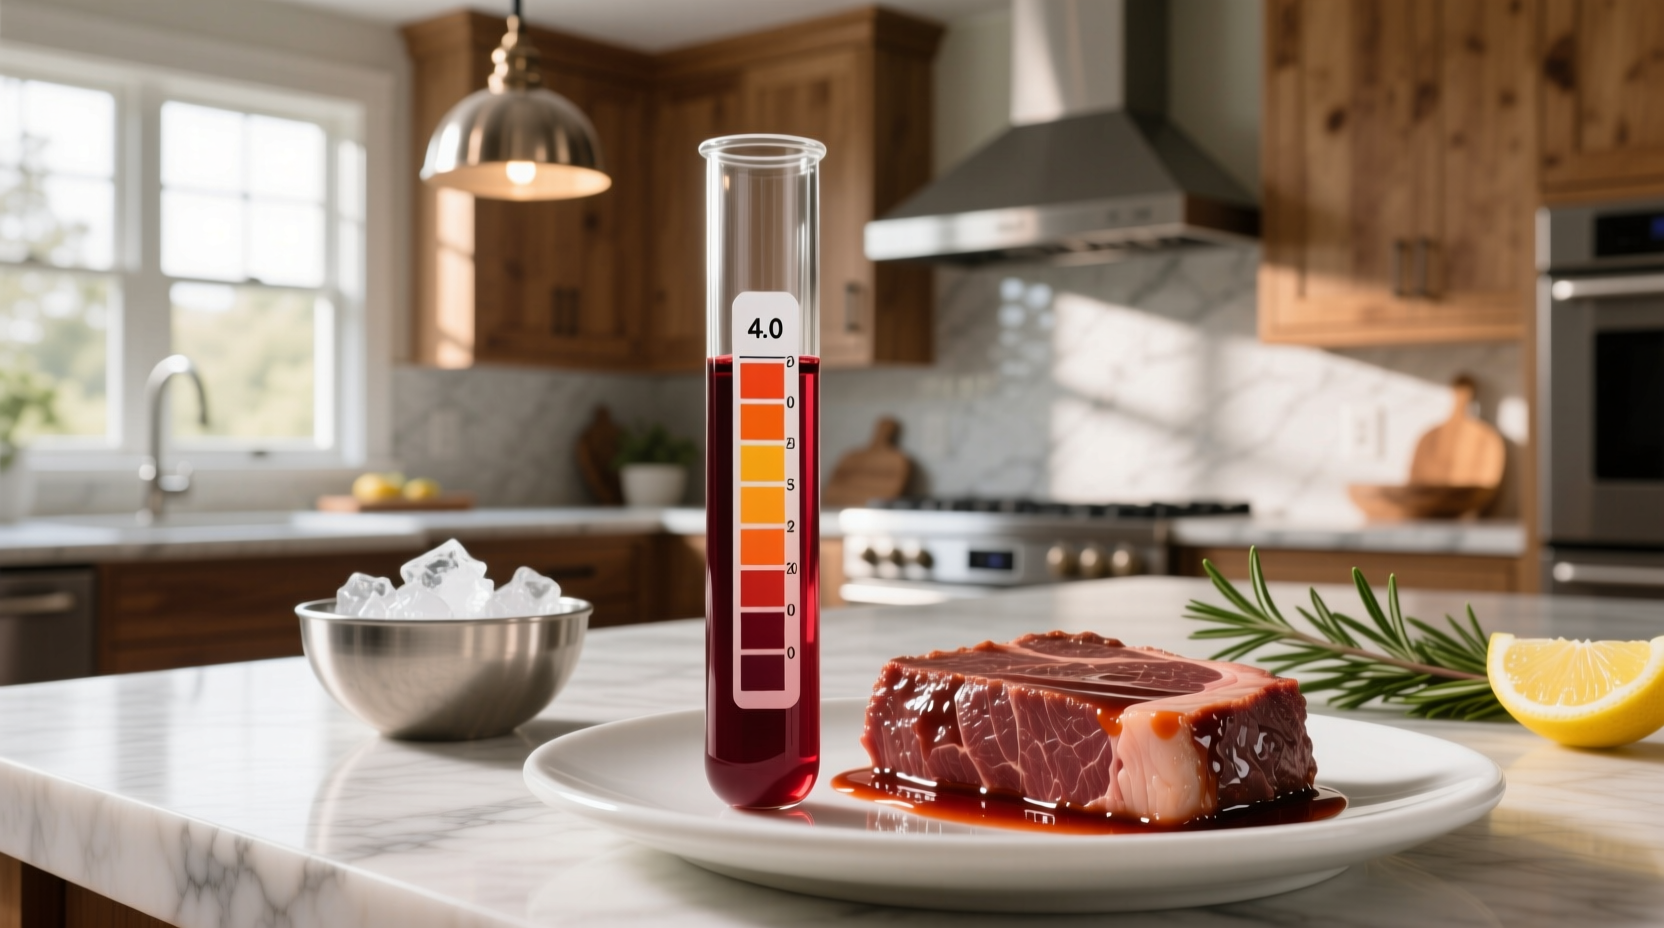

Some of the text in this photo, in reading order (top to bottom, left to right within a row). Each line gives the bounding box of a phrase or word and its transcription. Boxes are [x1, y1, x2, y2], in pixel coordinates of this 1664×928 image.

[747, 317, 783, 339] 4.0
[787, 396, 795, 408] 0
[787, 520, 795, 532] 2
[787, 604, 795, 616] 0
[787, 646, 795, 659] 0
